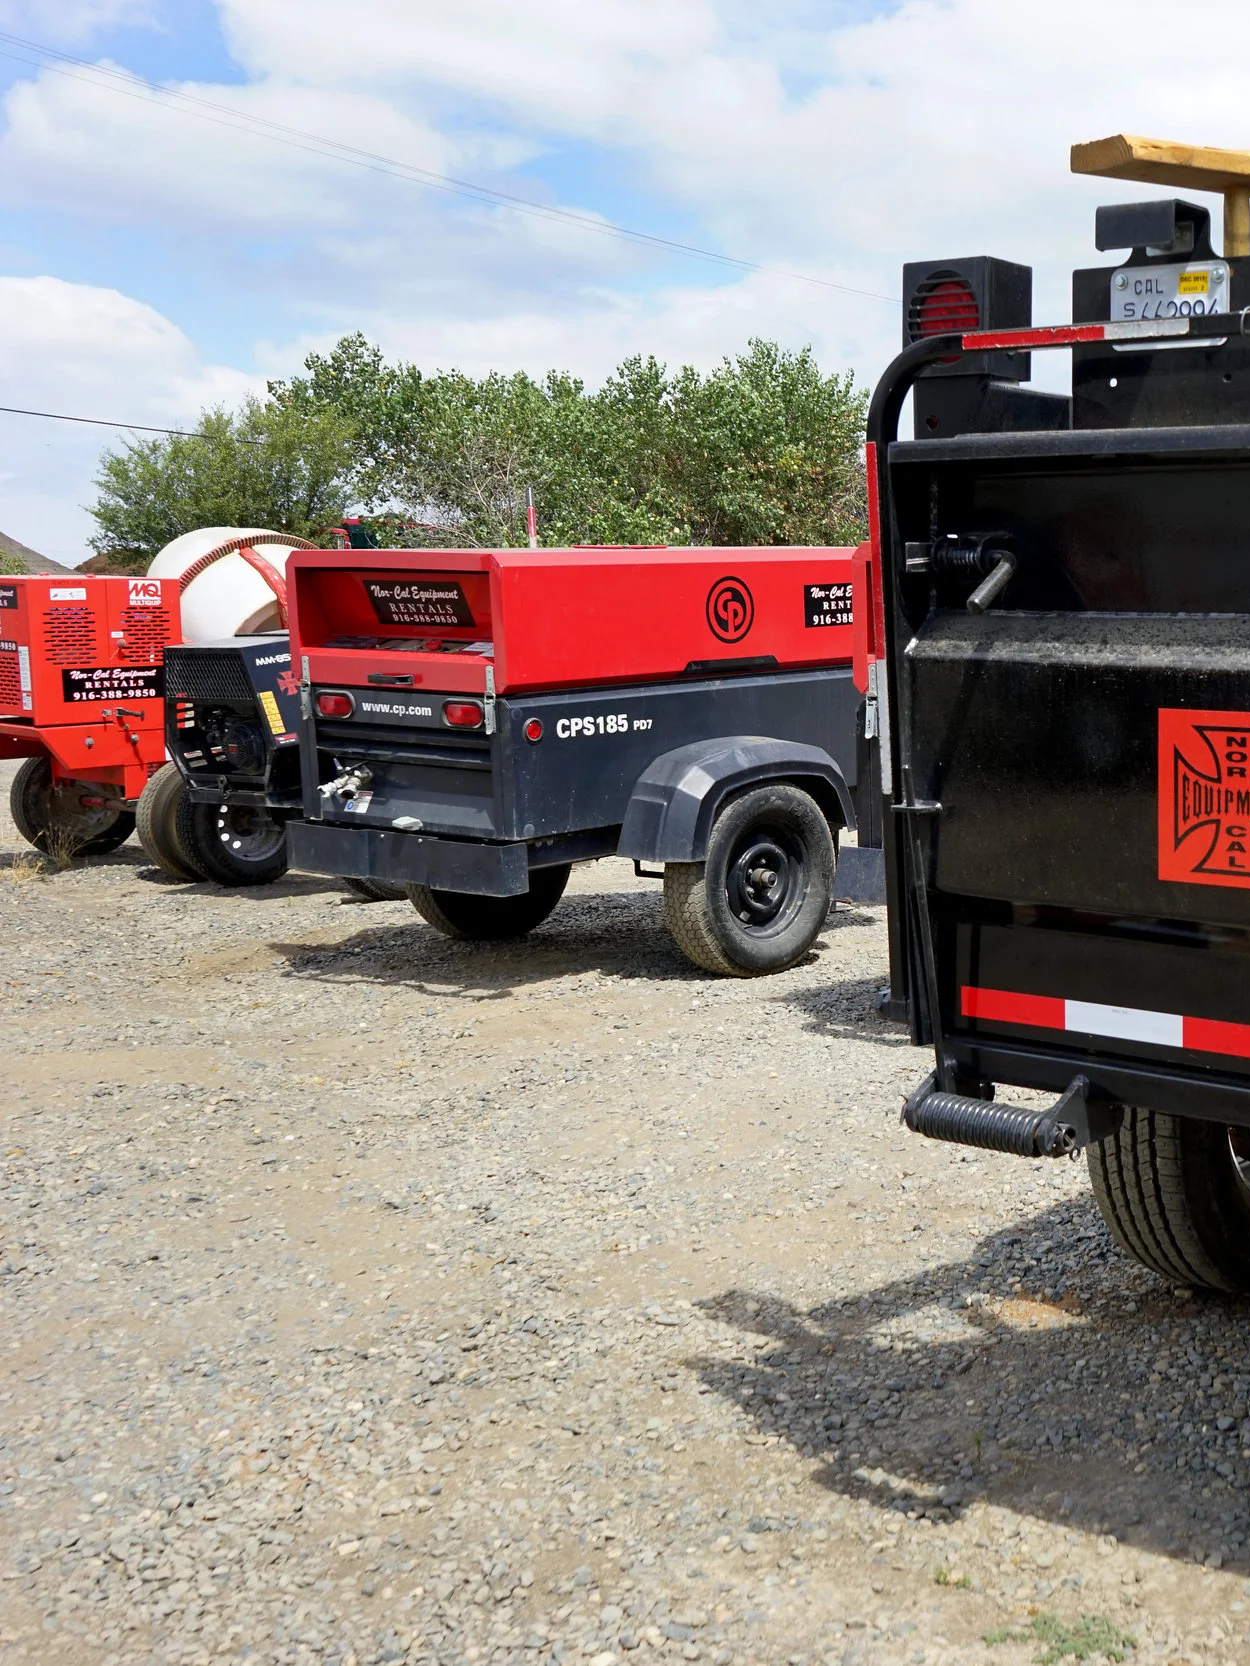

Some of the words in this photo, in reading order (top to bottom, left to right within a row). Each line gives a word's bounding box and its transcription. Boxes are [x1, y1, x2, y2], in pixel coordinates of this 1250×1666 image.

[1134, 279, 1164, 295] CAL
[129, 583, 161, 598] MQ
[371, 585, 411, 599] Nor-Cal
[412, 586, 459, 601] Equipment
[810, 586, 844, 599] Nor-Cal
[389, 602, 453, 614] RENTALS
[393, 614, 458, 623] 916-388-9850
[70, 669, 111, 680] Nor-Cal
[113, 669, 156, 680] Equipment
[85, 679, 145, 689] RENTALS
[73, 689, 156, 701] 916-388-9850
[362, 702, 432, 716] www.cp.com
[556, 713, 628, 739] CPS185
[633, 719, 653, 731] PD7
[1225, 736, 1248, 778] NOR
[1225, 825, 1247, 868] CAL
